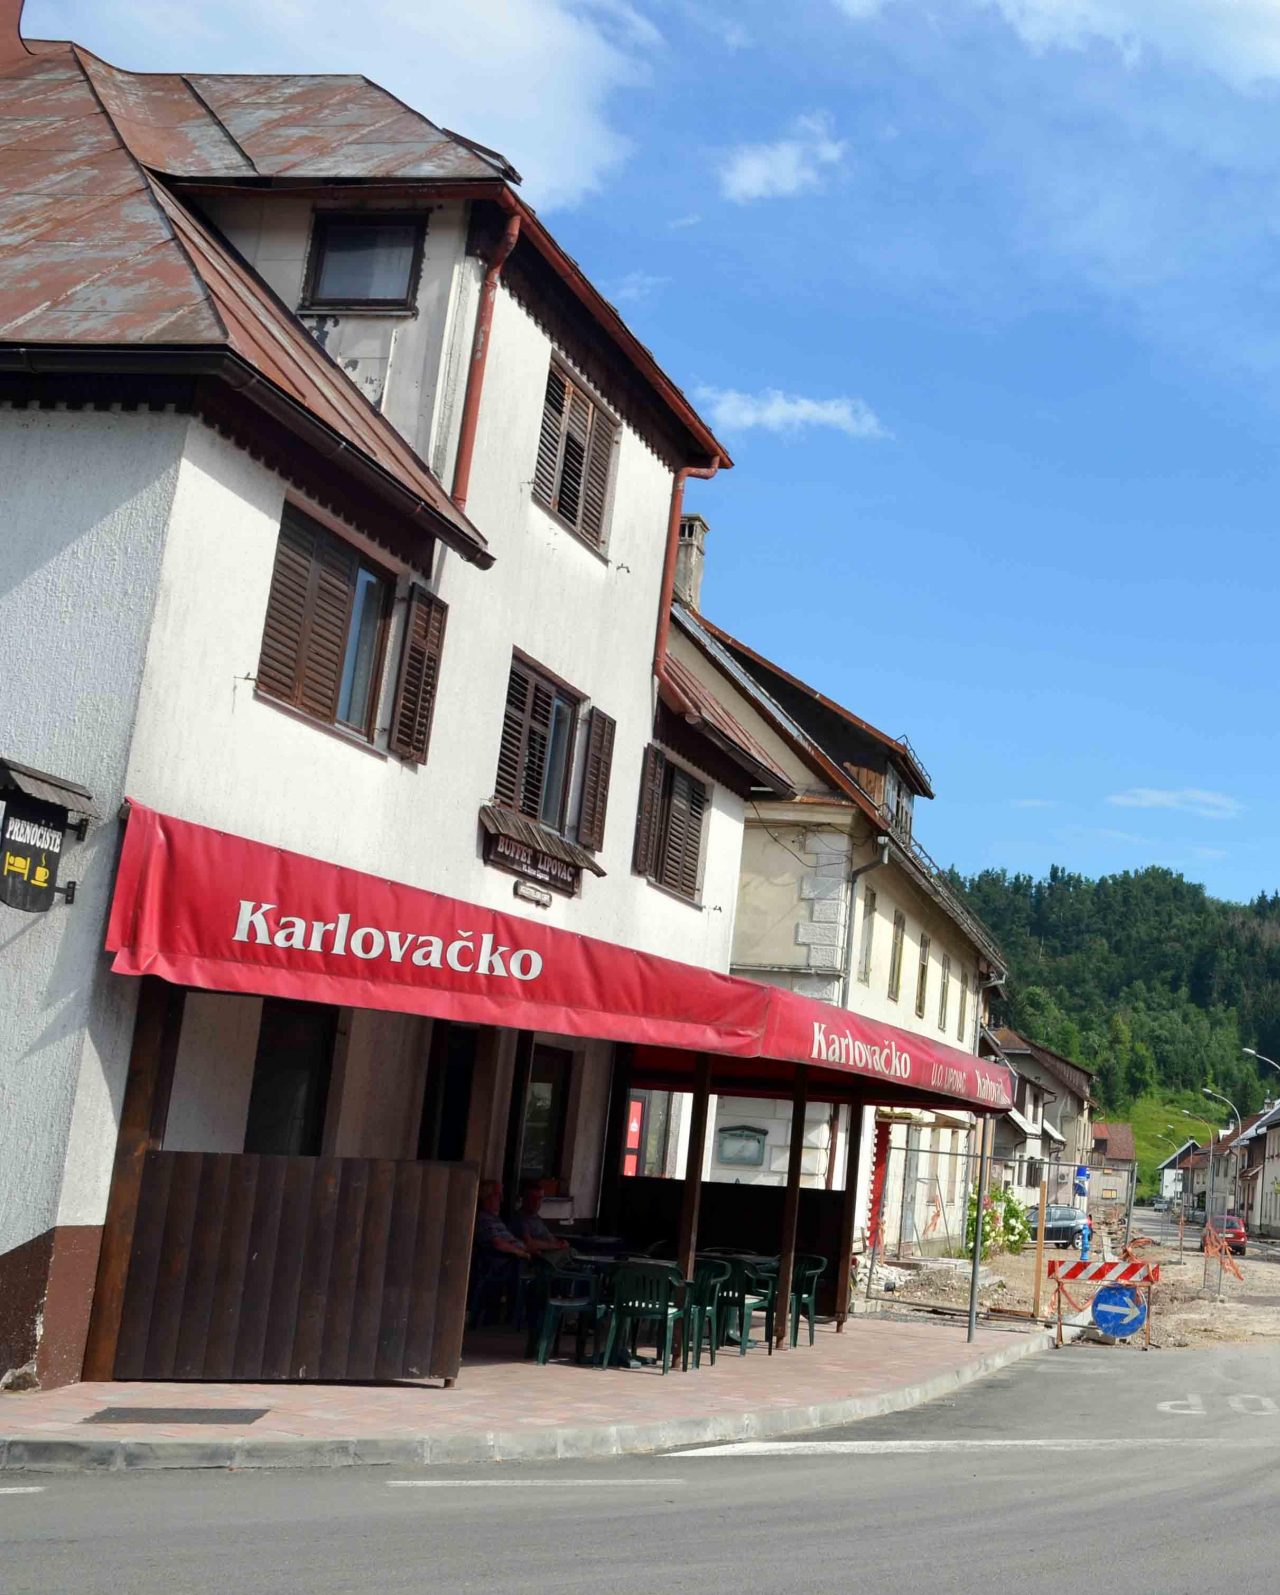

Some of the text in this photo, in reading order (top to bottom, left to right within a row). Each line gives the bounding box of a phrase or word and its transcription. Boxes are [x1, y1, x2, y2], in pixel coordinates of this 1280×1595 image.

[497, 836, 534, 864] BUFFET
[232, 900, 543, 981] Karlovačko
[811, 1022, 911, 1078] Karlovačko
